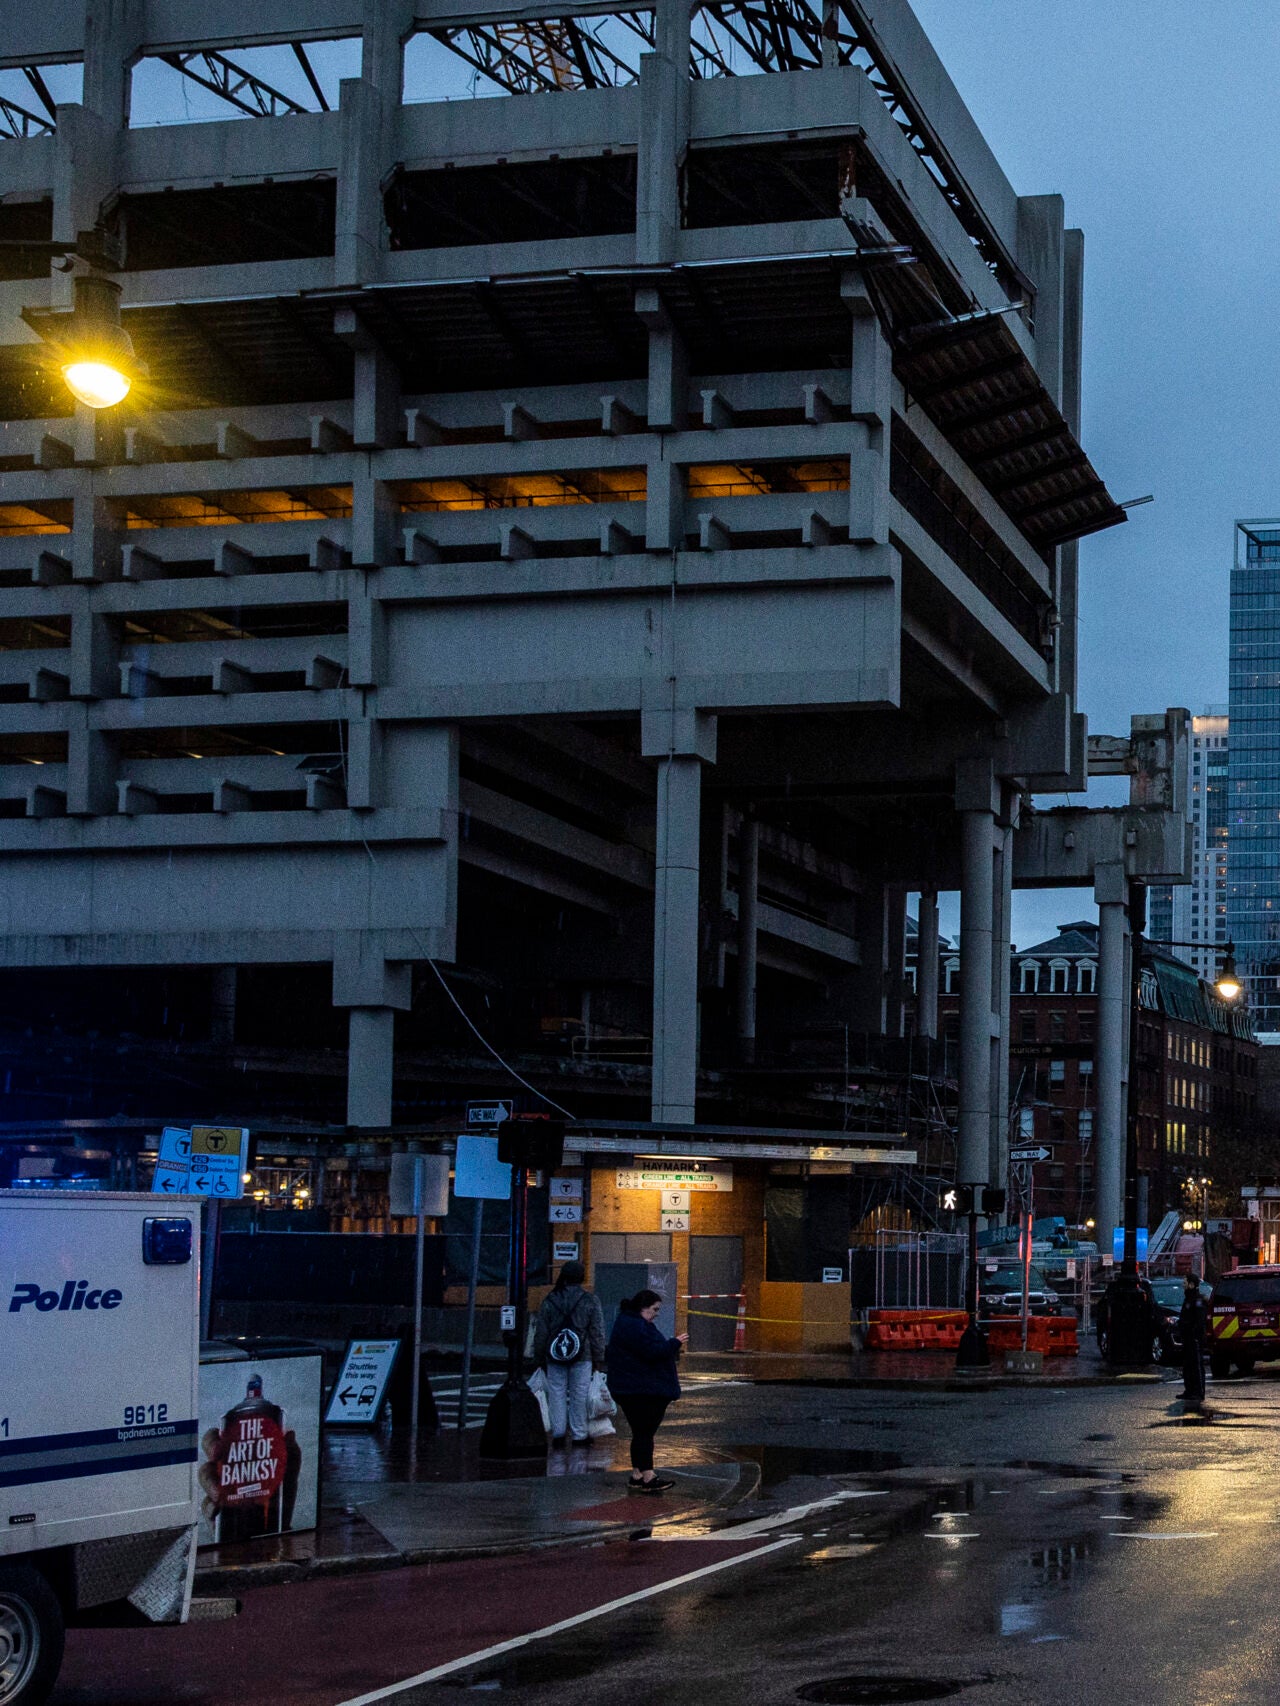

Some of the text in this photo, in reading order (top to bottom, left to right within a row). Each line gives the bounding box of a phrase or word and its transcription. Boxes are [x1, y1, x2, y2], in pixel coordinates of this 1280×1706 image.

[470, 1108, 497, 1120] ONE WAY
[210, 1136, 223, 1148] T
[562, 1184, 571, 1193] T
[8, 1280, 123, 1313] Police
[124, 1403, 168, 1425] 9612
[117, 1425, 176, 1441] bpdnews.com
[239, 1418, 265, 1440] THE
[228, 1438, 274, 1463] ART OF
[221, 1458, 279, 1486] BANKSY
